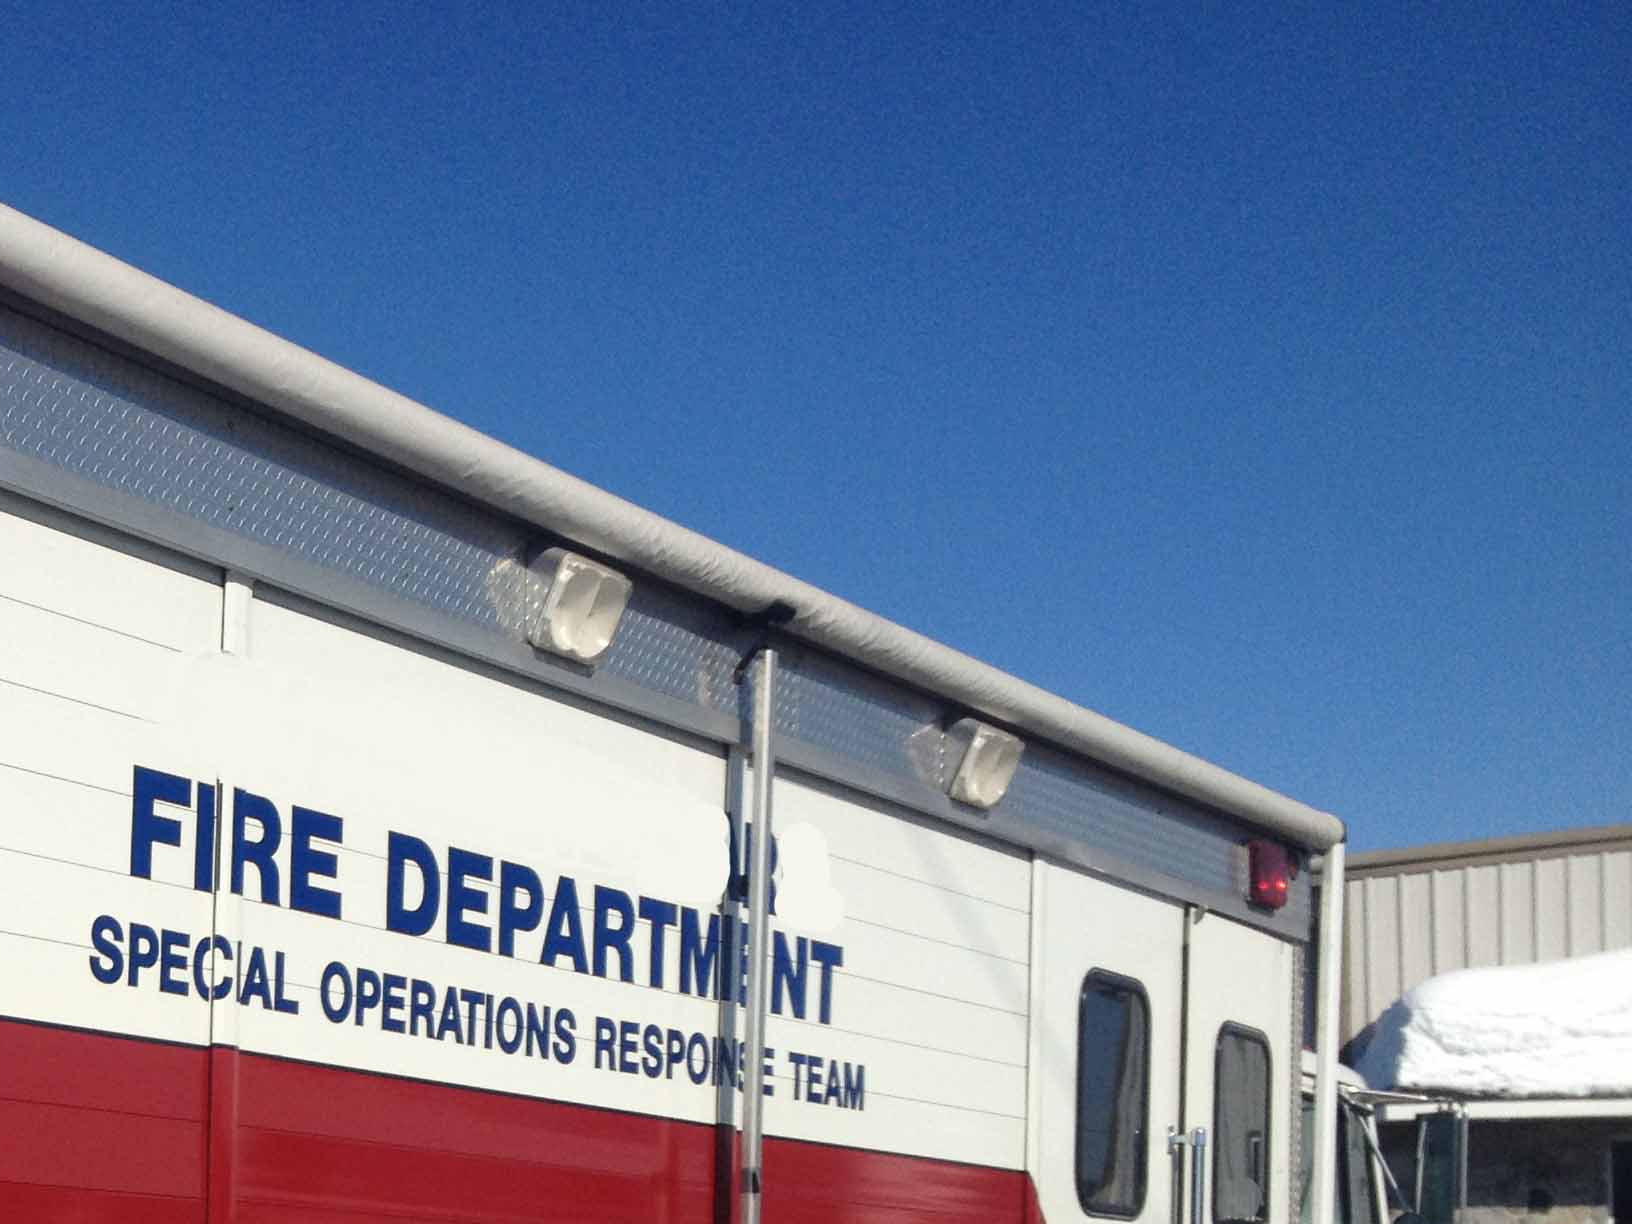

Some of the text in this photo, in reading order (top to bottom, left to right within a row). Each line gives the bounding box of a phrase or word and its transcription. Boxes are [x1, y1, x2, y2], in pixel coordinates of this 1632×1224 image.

[130, 764, 344, 921] FIRE
[89, 914, 299, 1015] SPECIAL
[320, 960, 577, 1065] OPERATIONS
[788, 1051, 866, 1111] TEAM
